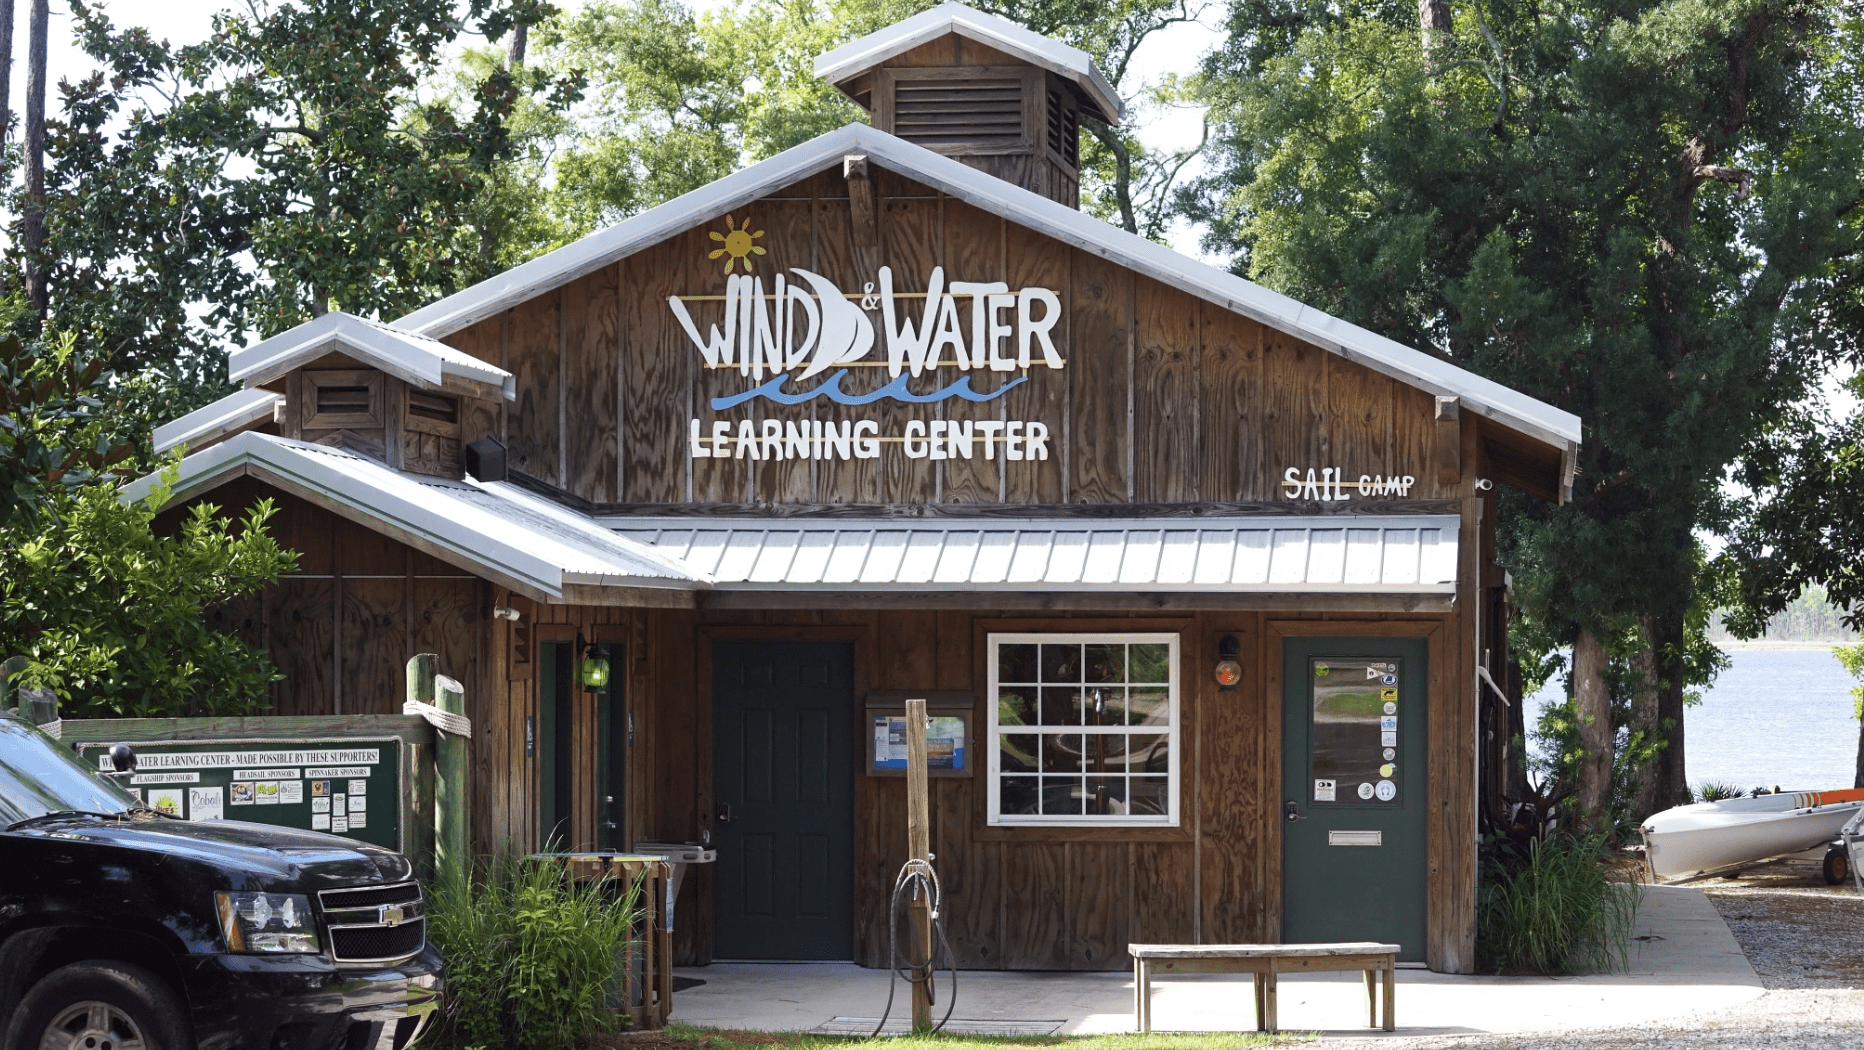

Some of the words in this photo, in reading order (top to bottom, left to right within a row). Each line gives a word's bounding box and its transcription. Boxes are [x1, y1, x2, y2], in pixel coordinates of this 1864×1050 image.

[669, 272, 820, 380] WIND
[861, 281, 881, 310] &
[878, 266, 1064, 378] WATER
[690, 418, 880, 461] LEARNING
[904, 419, 1050, 461] CENTER
[1284, 466, 1350, 501] SAIL
[1358, 474, 1415, 497] CAMP
[136, 756, 159, 767] ATER
[160, 755, 199, 766] LEARNING
[200, 754, 231, 765] CENTER
[236, 754, 258, 764] MADE
[259, 753, 294, 764] POSSIBLE
[294, 752, 304, 763] BY
[305, 752, 329, 763] THESE
[330, 751, 378, 762] SUPPORTERS!
[136, 774, 164, 783] FLAGSHIP
[165, 774, 194, 782] SPONSORS
[239, 771, 266, 779] HEADSAIL
[267, 770, 296, 778] SPONSORS
[308, 769, 339, 777] SPINNAKER
[340, 768, 367, 776] SPONSORS
